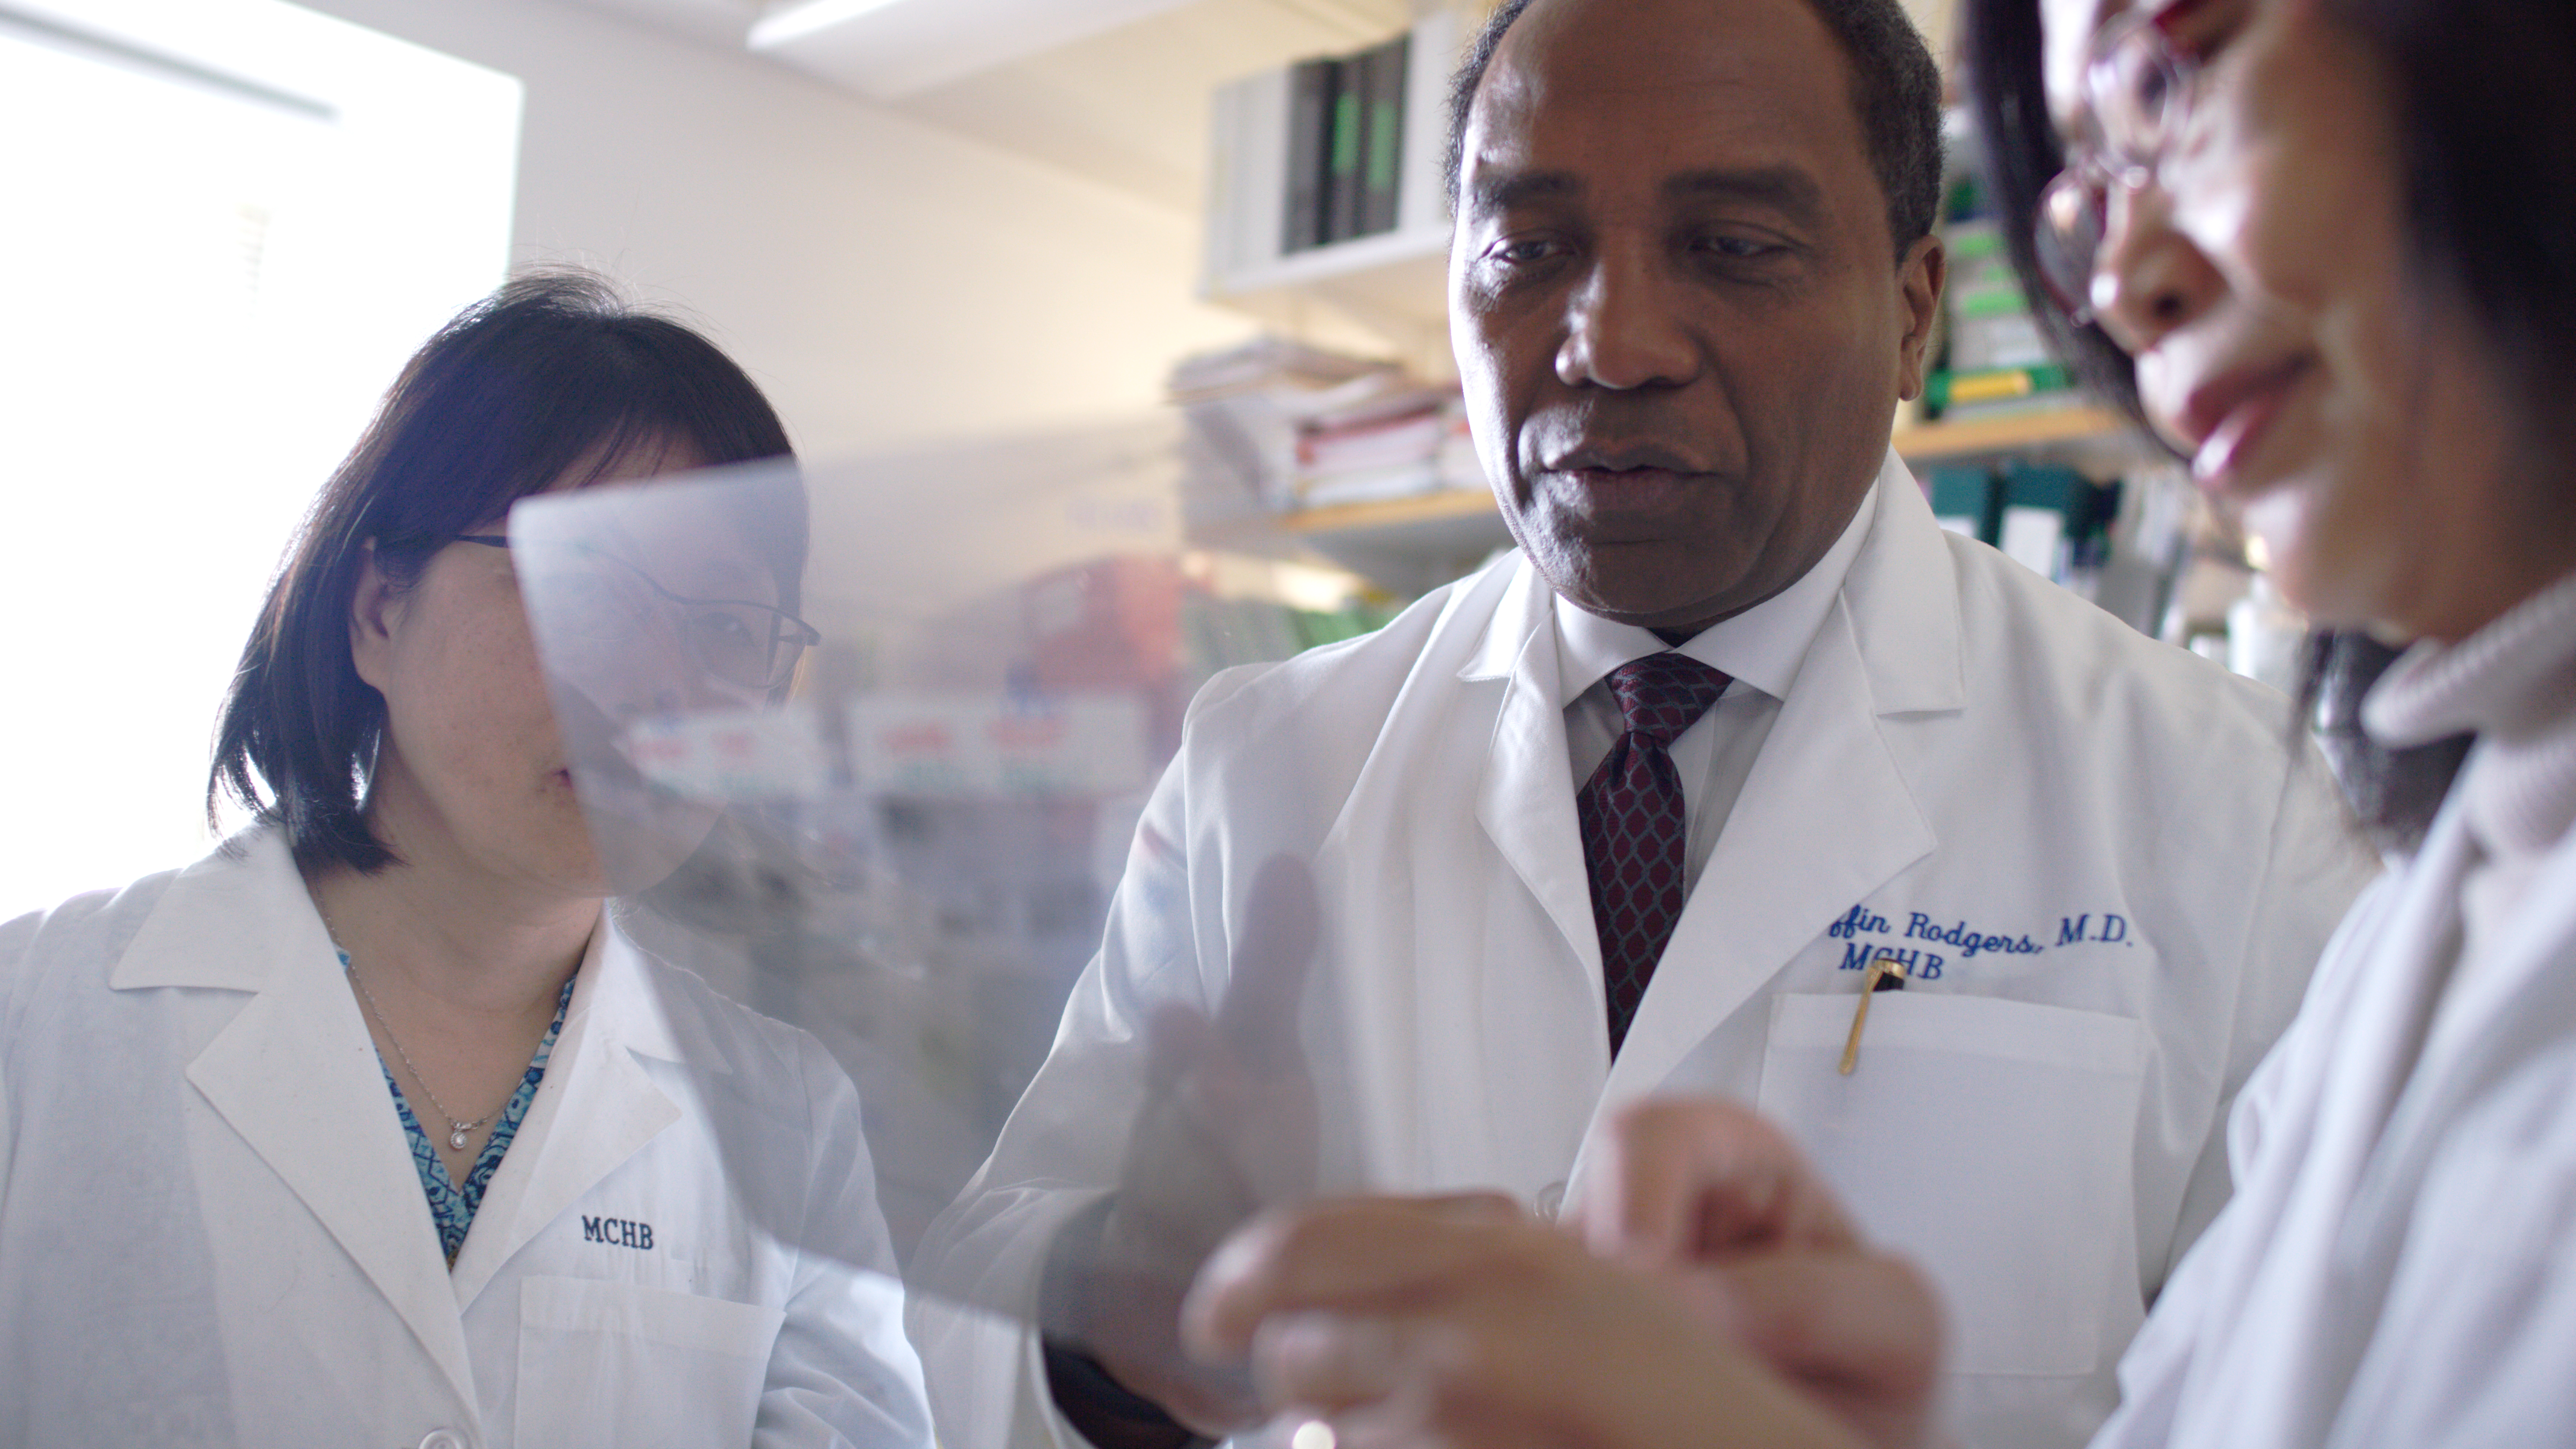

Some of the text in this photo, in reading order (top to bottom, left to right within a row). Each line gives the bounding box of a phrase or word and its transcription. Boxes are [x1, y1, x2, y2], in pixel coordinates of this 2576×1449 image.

[1904, 912, 2044, 957] Rodgers,
[2055, 914, 2133, 947] M.D.
[581, 1215, 654, 1250] MCHB
